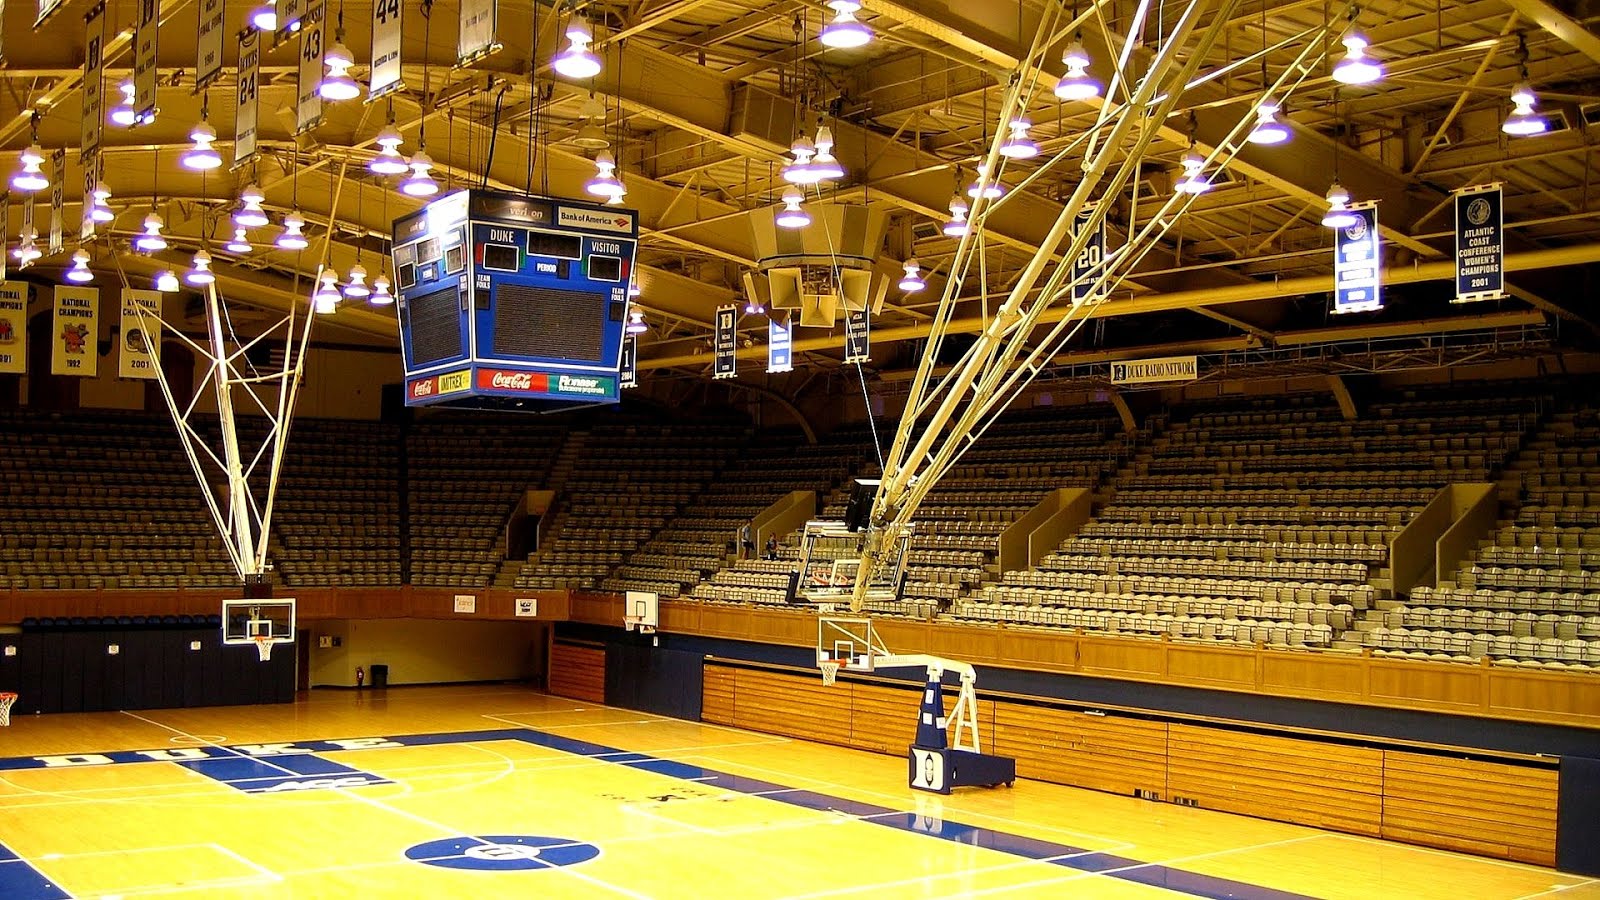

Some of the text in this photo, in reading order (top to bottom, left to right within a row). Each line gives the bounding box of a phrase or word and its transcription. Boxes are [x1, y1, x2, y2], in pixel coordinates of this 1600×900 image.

[376, 0, 399, 24] 44
[303, 29, 321, 62] 43
[240, 72, 255, 106] 24
[561, 212, 612, 226] Bank of America
[490, 229, 514, 243] DUKE
[1464, 226, 1494, 238] ATLANTIC
[1469, 236, 1490, 246] COAST
[592, 241, 620, 254] VISITOR
[1458, 244, 1500, 258] CONFERENCE
[1077, 245, 1100, 269] 20
[1464, 254, 1495, 266] WOMEN'S
[536, 263, 557, 273] PERIOD
[1460, 264, 1499, 276] CHAMPIONS
[477, 274, 491, 282] TEAM
[1471, 278, 1489, 288] 2001
[476, 281, 491, 290] FOULS
[62, 298, 91, 308] NATIONAL
[59, 308, 94, 318] CHAMPIONS
[66, 359, 81, 368] 1992
[131, 360, 150, 368] 2001
[1128, 365, 1144, 378] DUKE
[1145, 363, 1165, 376] RADIO
[1166, 361, 1196, 376] NETWORK
[32, 737, 405, 767] DUKE
[266, 777, 366, 792] ACC
